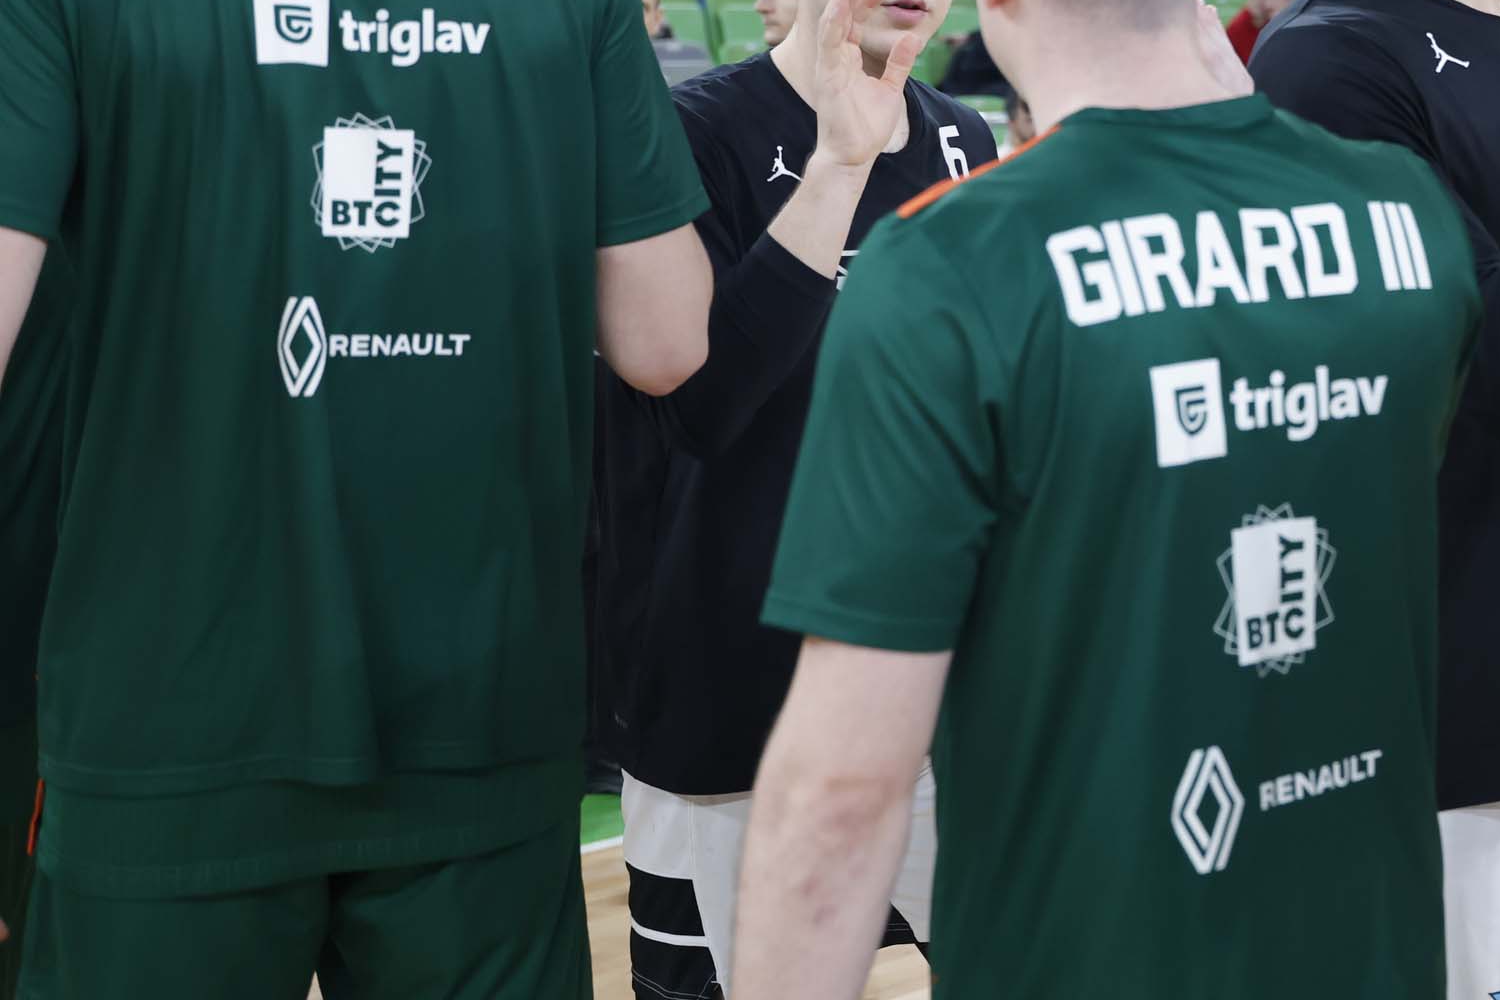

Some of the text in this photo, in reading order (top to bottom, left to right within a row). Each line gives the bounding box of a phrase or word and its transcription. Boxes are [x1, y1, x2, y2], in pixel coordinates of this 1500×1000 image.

[339, 8, 490, 67] triglav
[331, 200, 401, 227] BTC
[1046, 202, 1359, 327] GIRARD
[1367, 200, 1433, 290] III
[328, 333, 471, 357] RENAULT
[1229, 365, 1388, 441] triglav
[1246, 607, 1306, 649] BTC
[1259, 750, 1382, 811] RENAULT
